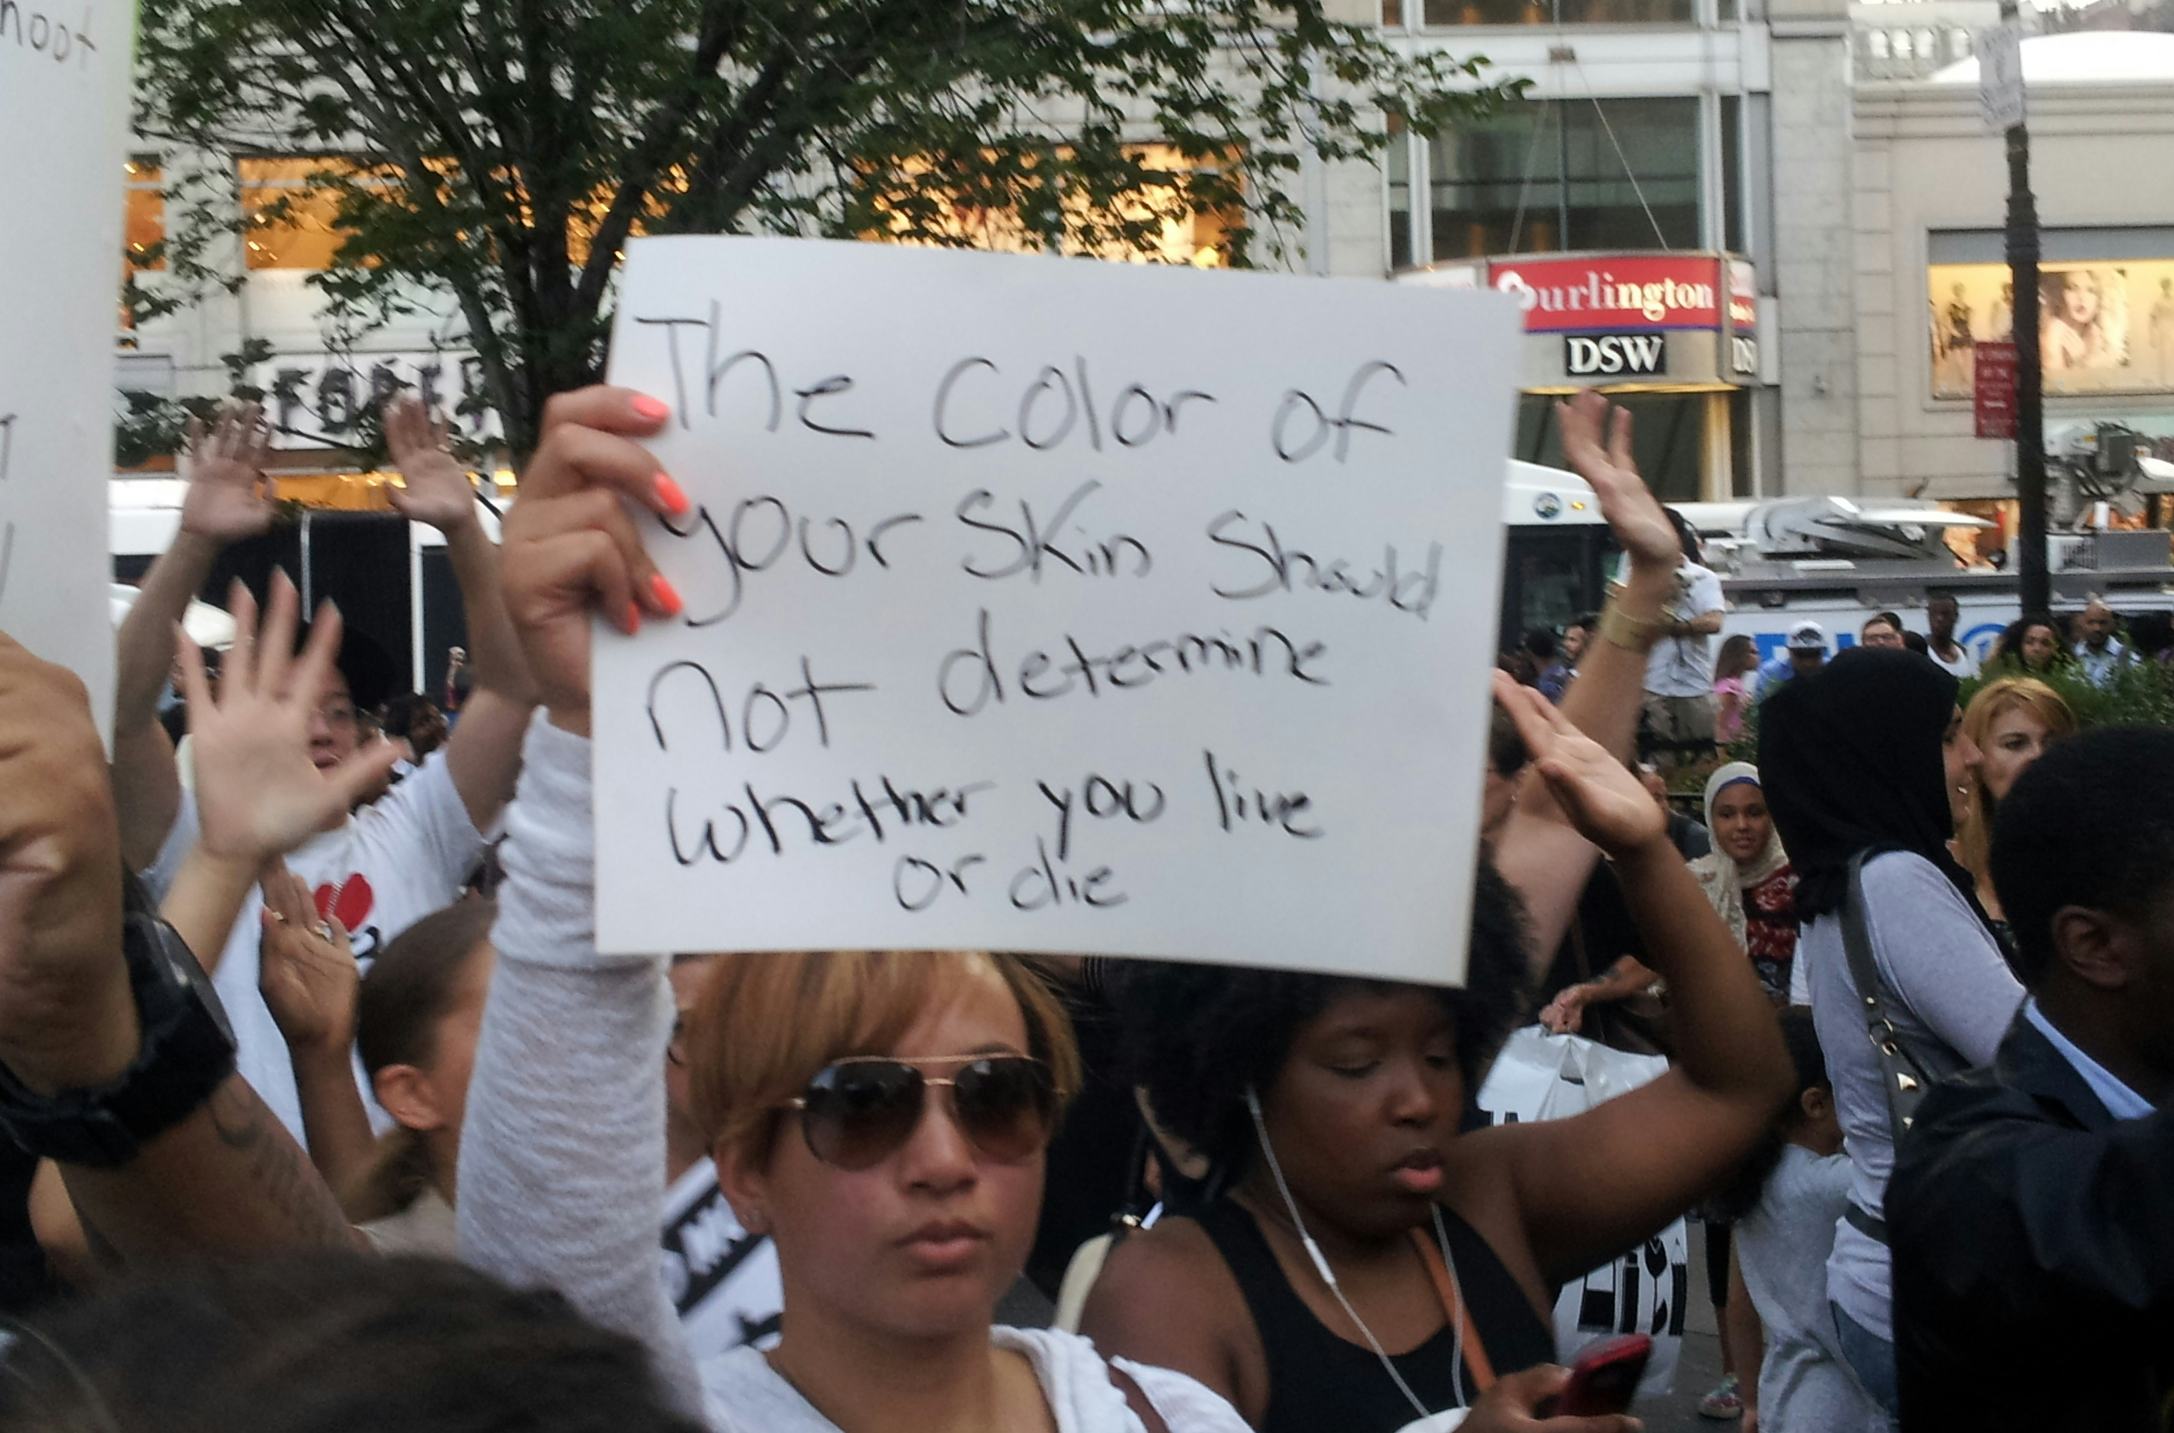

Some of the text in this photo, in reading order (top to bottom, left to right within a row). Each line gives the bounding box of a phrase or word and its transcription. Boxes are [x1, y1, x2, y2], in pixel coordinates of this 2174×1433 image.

[634, 299, 876, 439] The
[1567, 335, 1663, 374] DSW
[656, 494, 924, 628] your
[938, 607, 1331, 717] determine
[1036, 772, 1166, 862] you
[1202, 748, 1325, 840] live
[893, 835, 1130, 913] or die
